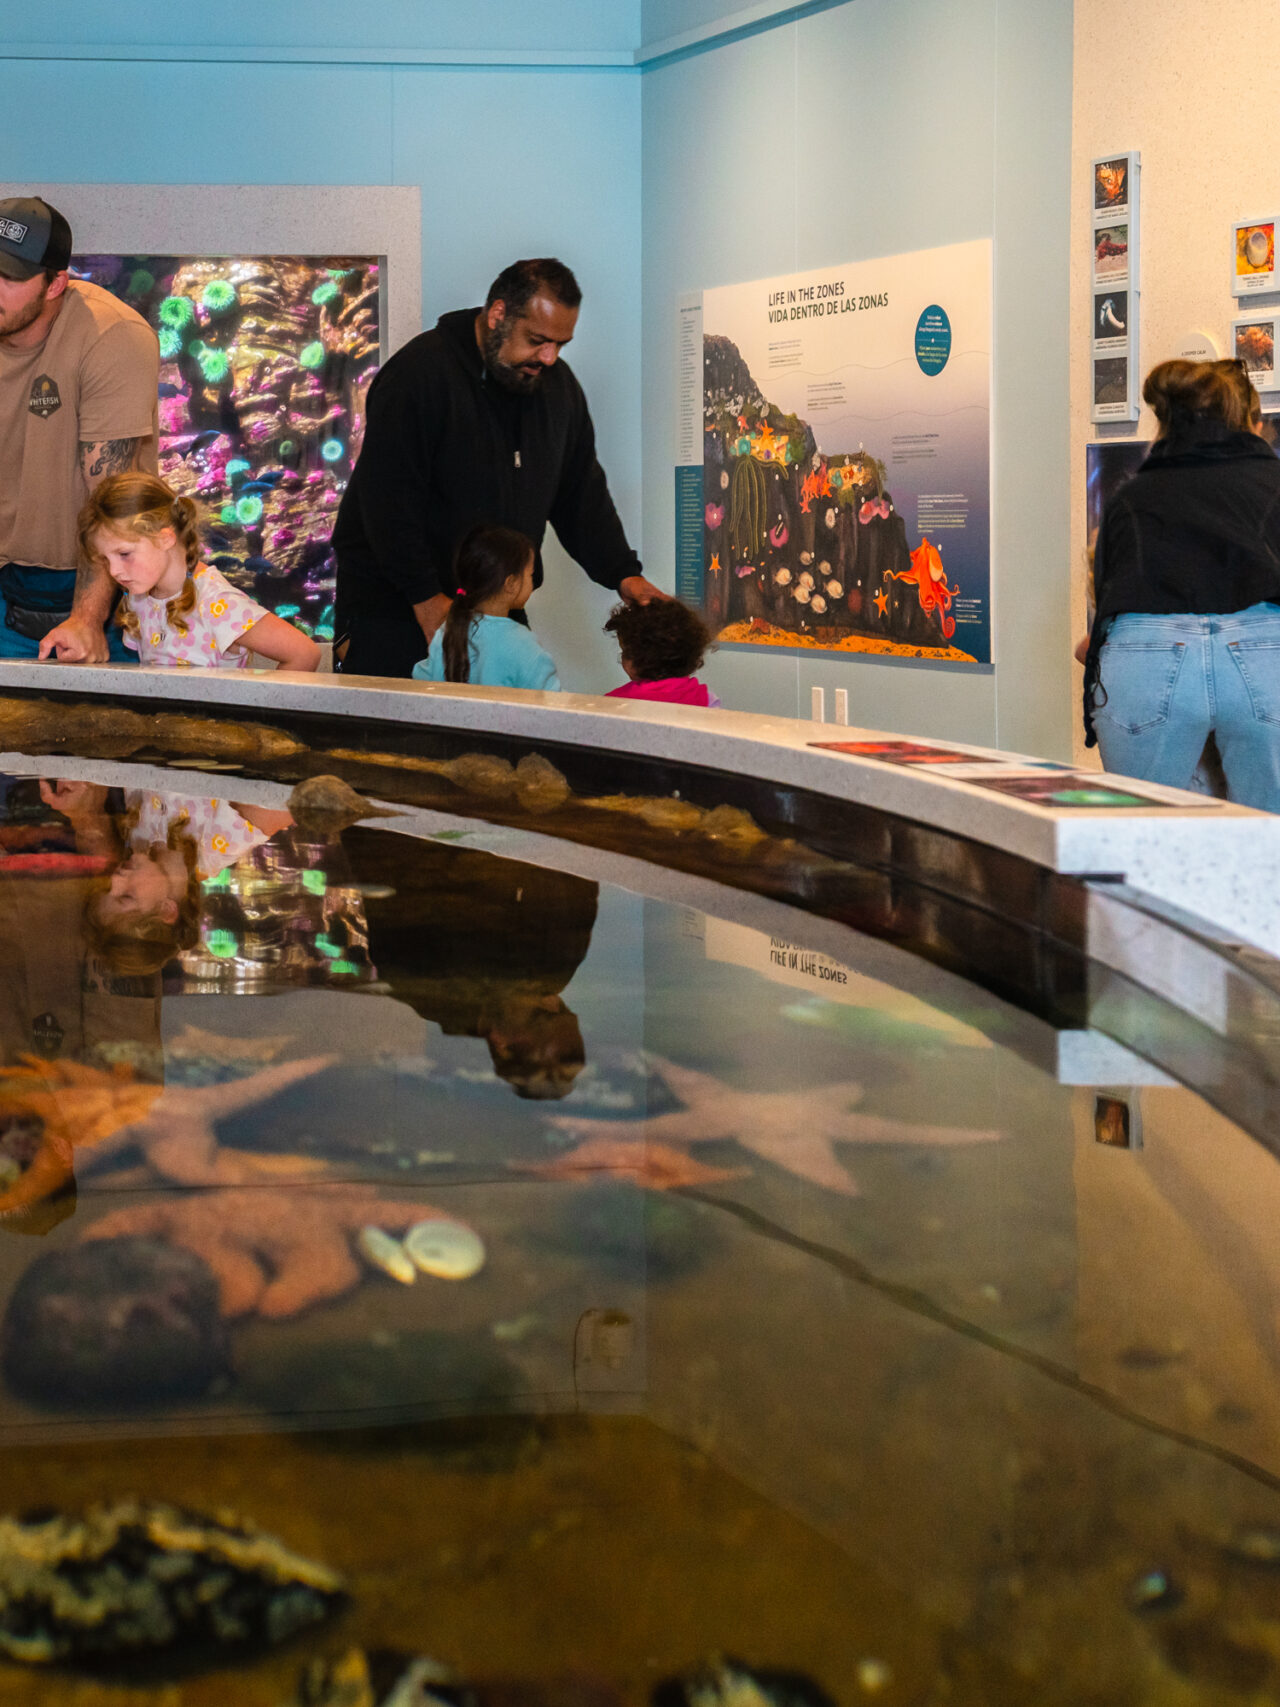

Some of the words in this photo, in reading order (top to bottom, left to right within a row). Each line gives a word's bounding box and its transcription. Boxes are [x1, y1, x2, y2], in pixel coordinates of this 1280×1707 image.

[768, 308, 788, 323] VIDA
[790, 302, 825, 321] DENTRO
[827, 300, 838, 315] DE
[840, 297, 856, 313] LAS
[858, 292, 889, 310] ZONAS
[769, 291, 785, 307] LIFE
[787, 289, 796, 304] IN
[798, 286, 815, 302] THE
[817, 281, 845, 299] ZONES
